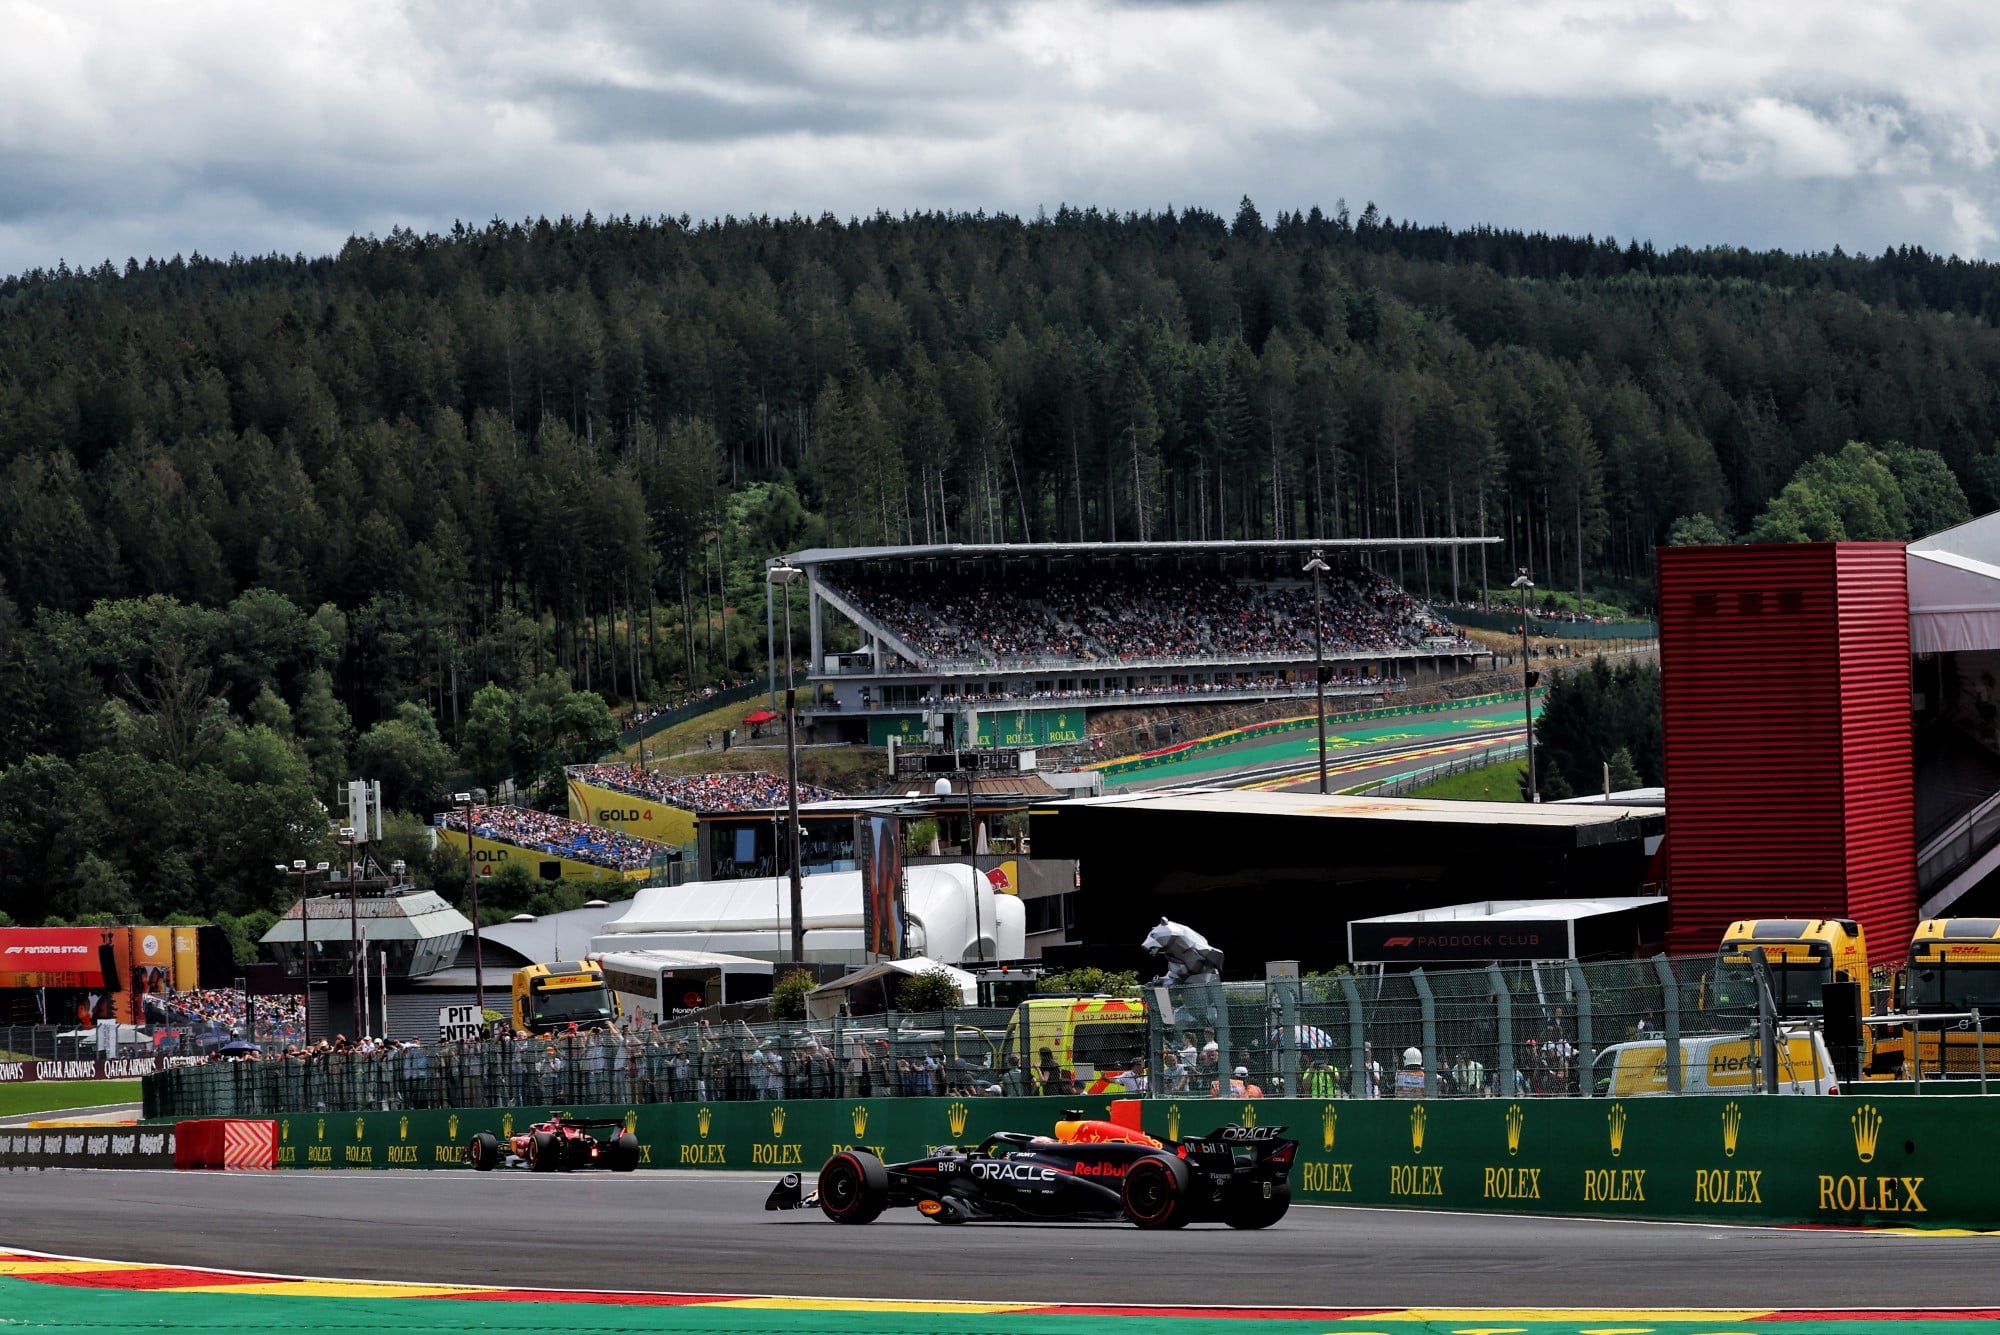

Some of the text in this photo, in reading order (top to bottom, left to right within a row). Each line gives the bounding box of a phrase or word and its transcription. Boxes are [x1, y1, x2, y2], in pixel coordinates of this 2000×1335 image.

[1006, 733, 1034, 744] ROLEX
[1049, 730, 1077, 742] ROLEX
[600, 809, 653, 821] GOLD 4
[473, 850, 508, 862] OLD
[481, 864, 493, 876] 4
[1418, 936, 1491, 947] PADDOCK
[1499, 935, 1539, 945] CLUB
[448, 1006, 473, 1023] PIT
[440, 1024, 484, 1041] ENTRY
[36, 1061, 95, 1079] QATAR AIRWAYS
[104, 1059, 127, 1078] QATAR
[126, 1056, 156, 1077] AIRWAYS
[1222, 1126, 1282, 1141] ORACLE
[278, 1147, 295, 1161] OLEX
[308, 1146, 332, 1162] ROLEX
[346, 1146, 372, 1162] ROLEX
[388, 1146, 417, 1162] ROLEX
[436, 1146, 464, 1162] ROLE
[680, 1144, 726, 1163] ROLEX
[752, 1144, 802, 1164] ROLEX
[1184, 1142, 1216, 1153] Mobil
[970, 1163, 1057, 1181] ORACLE
[1074, 1160, 1102, 1175] Red
[1303, 1163, 1352, 1191] ROLEX
[1391, 1165, 1443, 1195] ROLEX
[1484, 1168, 1541, 1199] ROLEX
[1584, 1169, 1646, 1201] ROLEX
[1695, 1169, 1762, 1203] ROLEX
[1818, 1174, 1927, 1212] ROLEX
